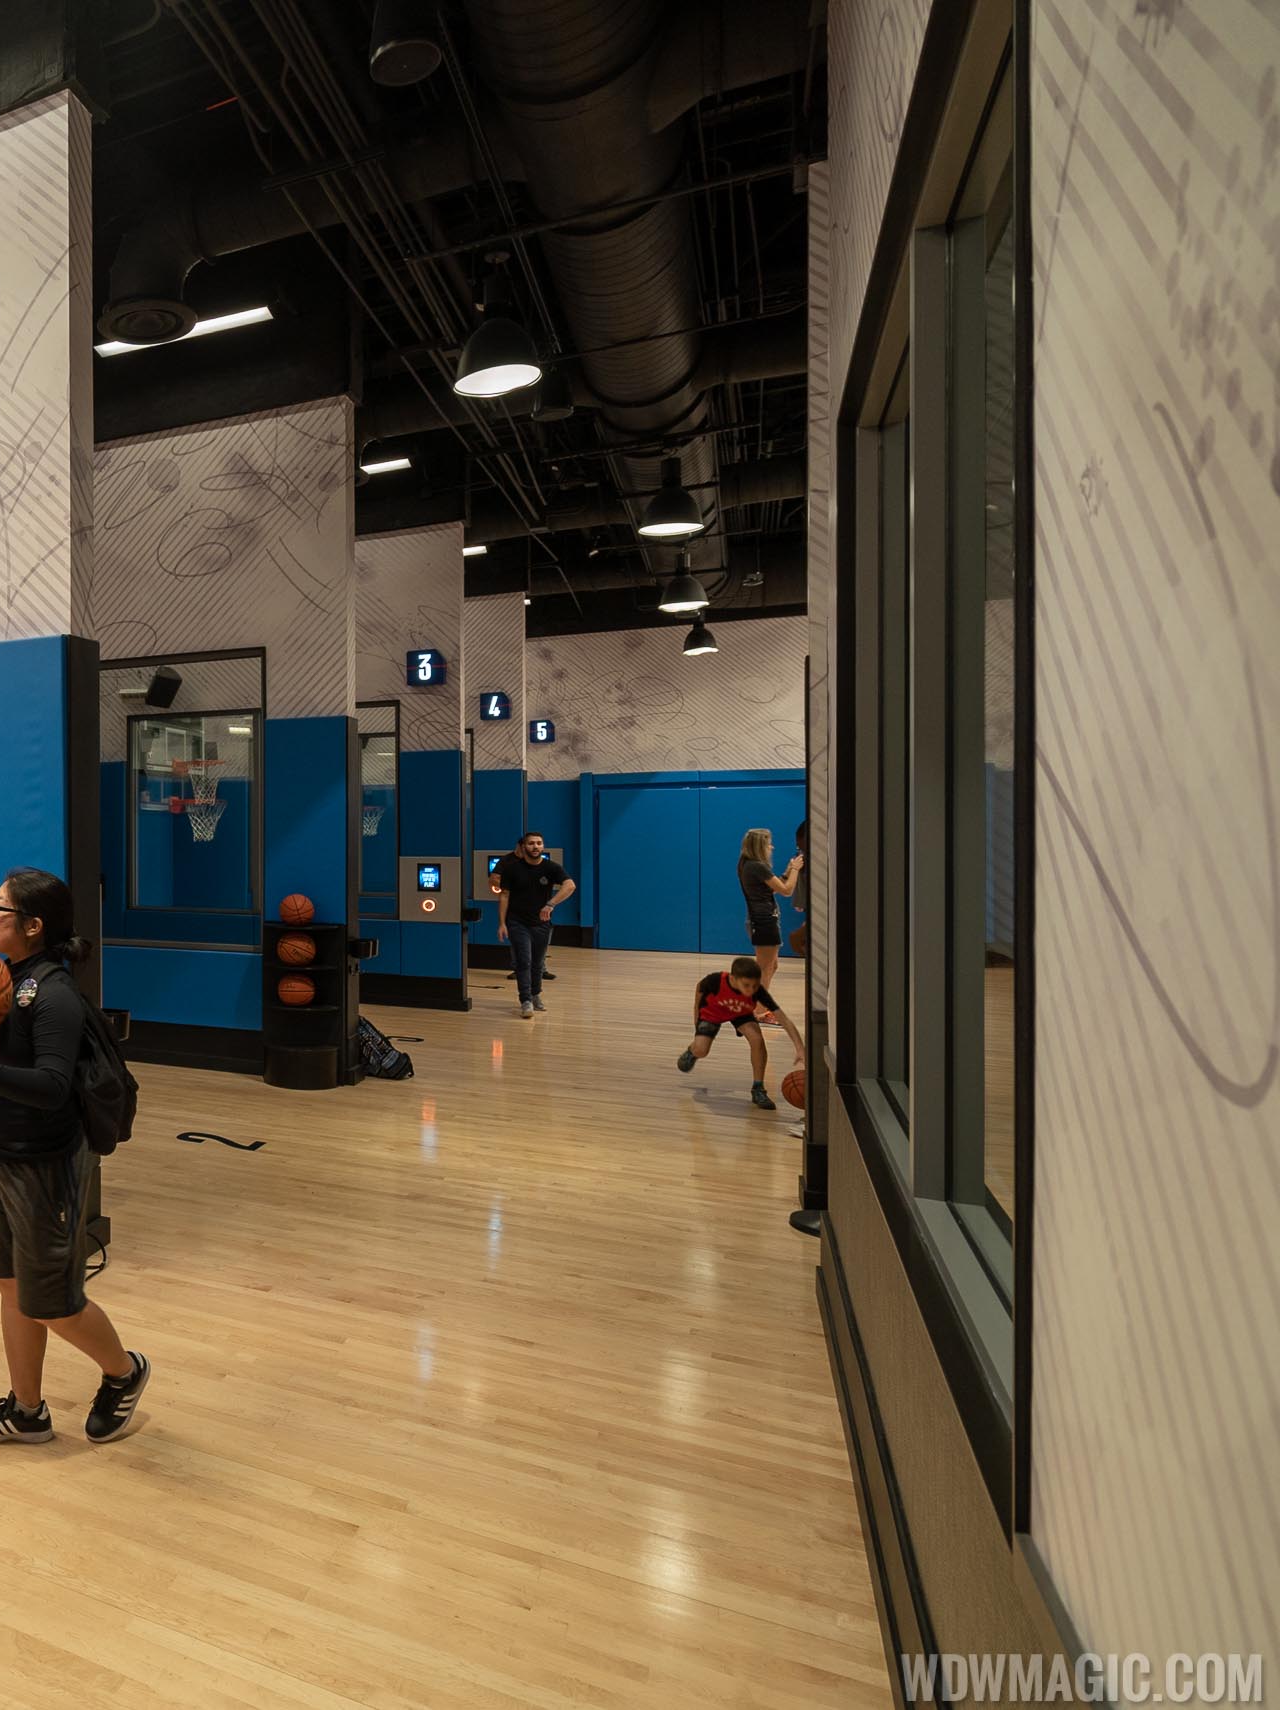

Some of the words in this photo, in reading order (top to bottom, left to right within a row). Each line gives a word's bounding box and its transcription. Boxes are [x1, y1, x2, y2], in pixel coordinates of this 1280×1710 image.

[418, 654, 432, 680] 3
[488, 695, 501, 717] 4
[536, 722, 548, 741] 5
